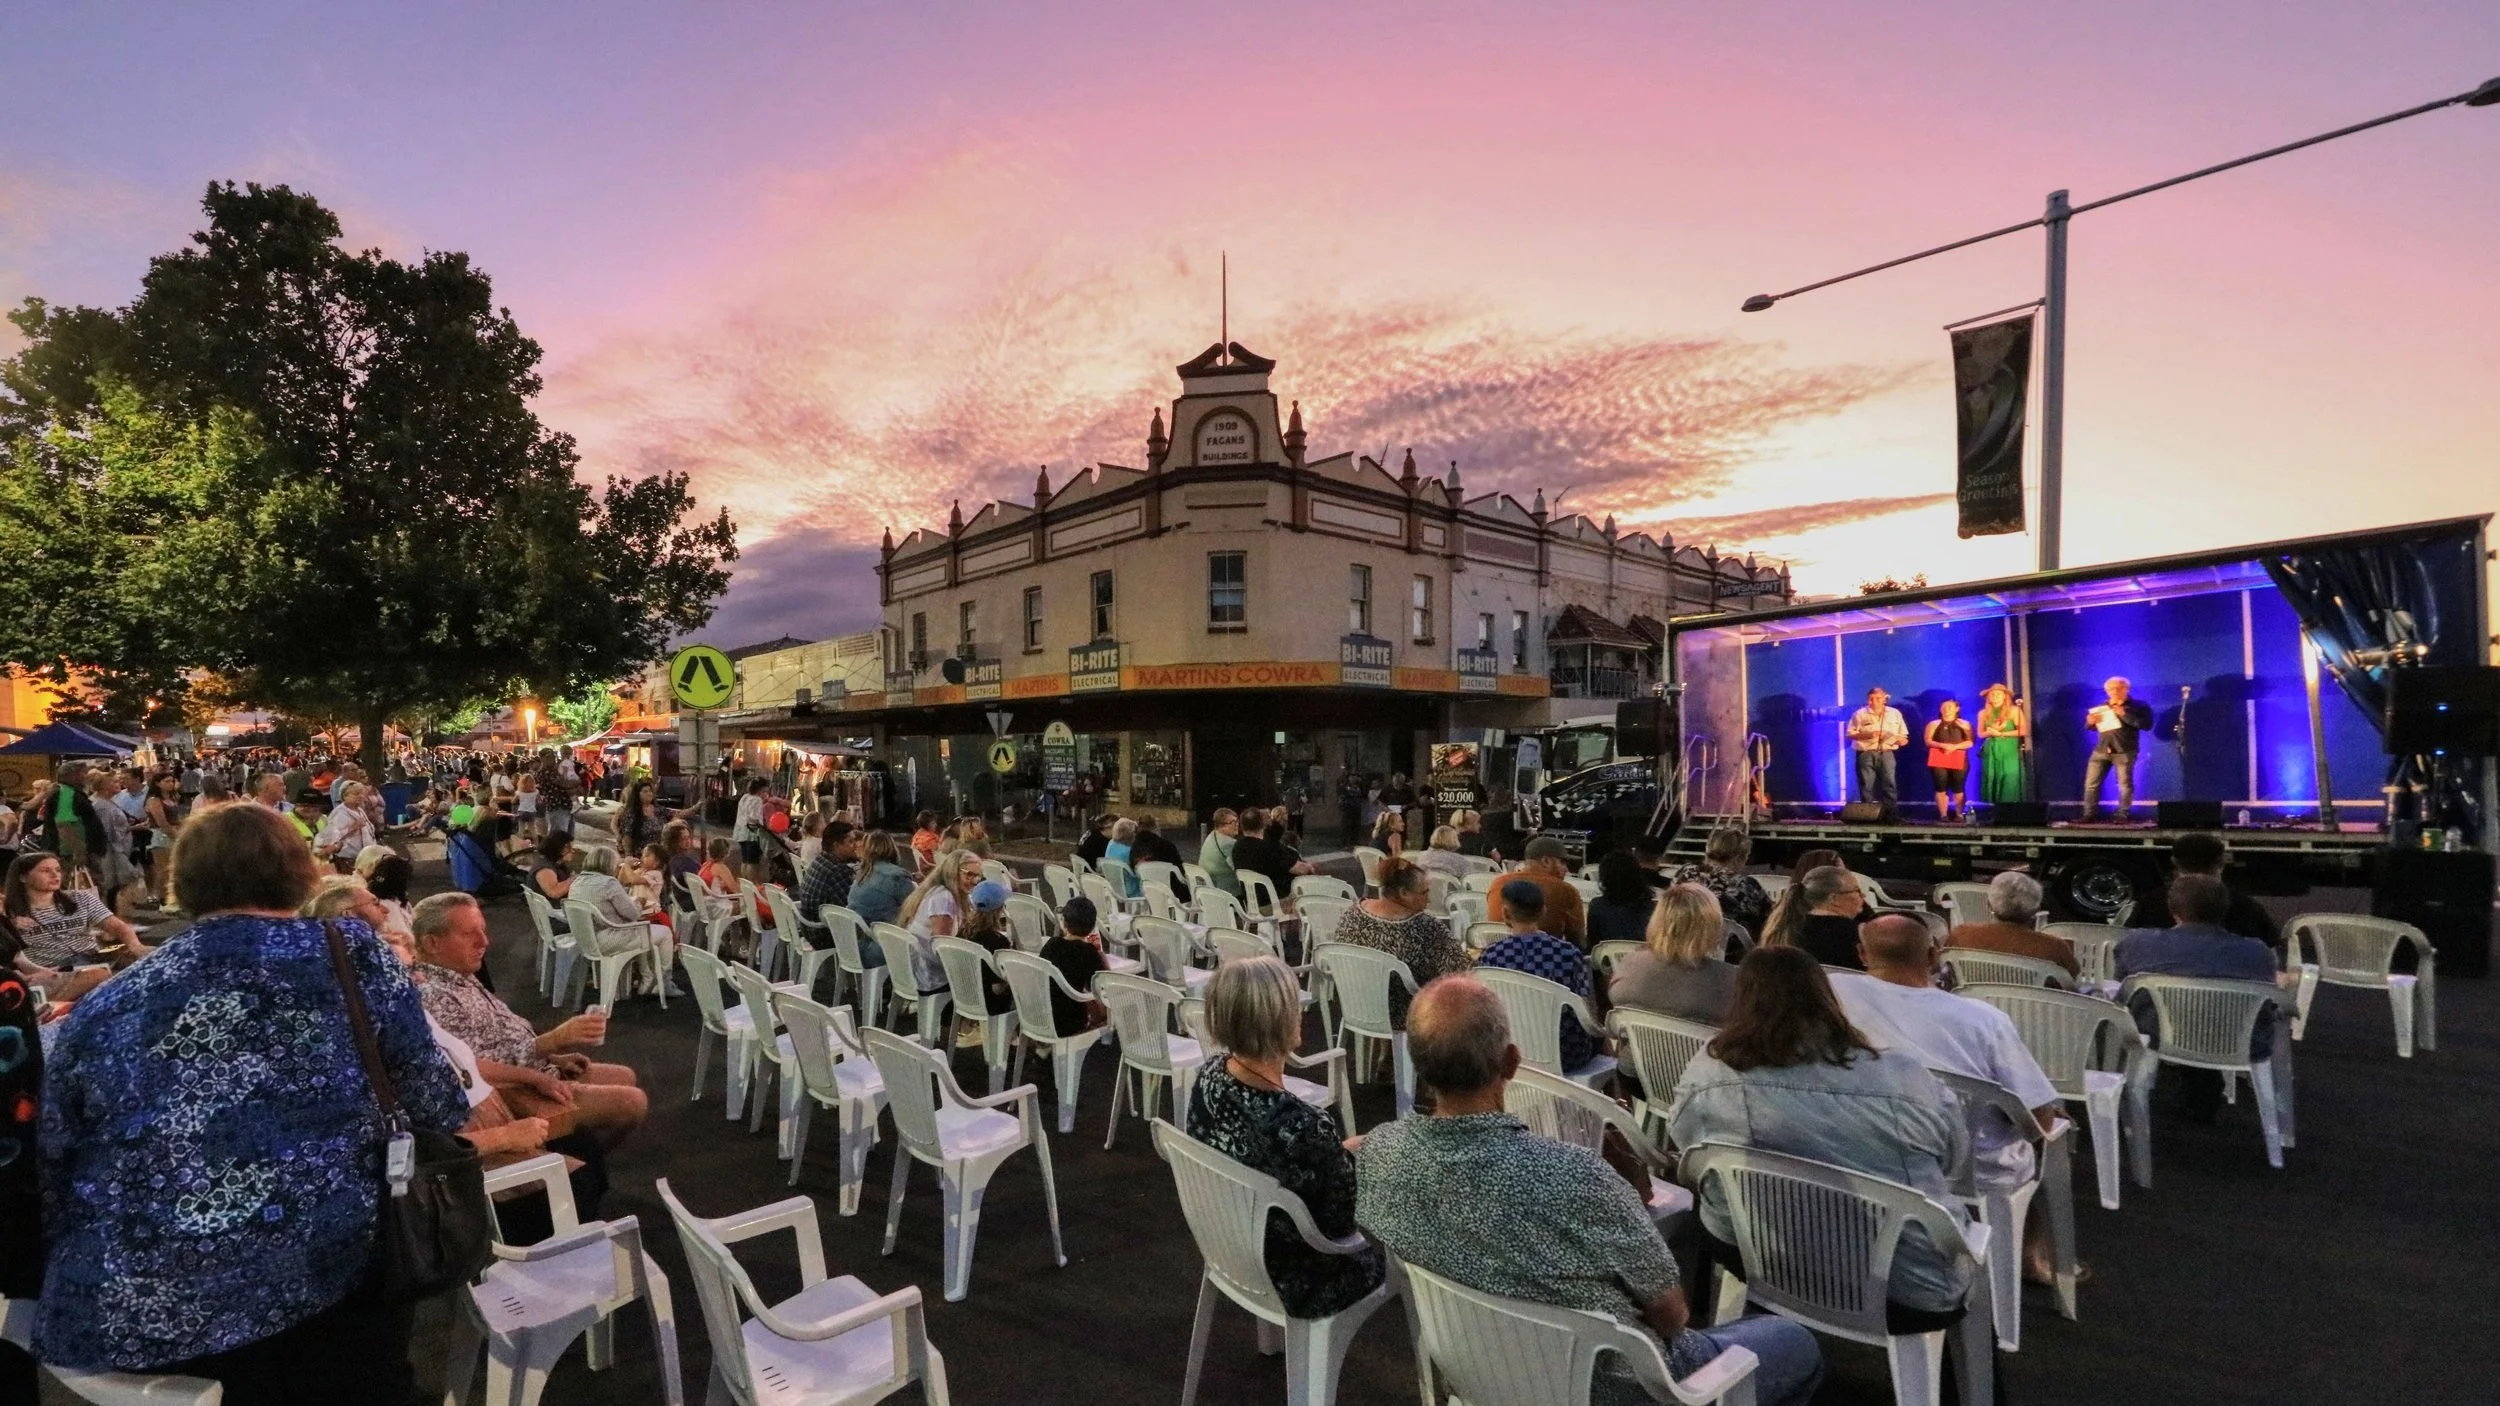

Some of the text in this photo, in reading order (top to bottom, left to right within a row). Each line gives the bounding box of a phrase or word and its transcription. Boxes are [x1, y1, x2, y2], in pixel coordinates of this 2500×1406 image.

[1206, 435, 1245, 446] FAGANS
[1202, 452, 1249, 461] BUILDINGS
[1720, 582, 1779, 596] NEWSAGENT
[1071, 649, 1118, 672] BI-RITE
[1342, 643, 1390, 666] BI-RITE
[1459, 654, 1497, 674] BI-RITE
[965, 664, 1000, 683] BI-RITE
[1073, 673, 1117, 688] ELECTRICAL
[1138, 666, 1324, 685] MARTINS COWRA
[1344, 670, 1389, 683] ELECTRICAL
[967, 686, 1000, 699] ELECTRICAL
[1011, 678, 1059, 695] MARTINS
[1048, 736, 1070, 745] COWRA
[1437, 792, 1474, 803] $20,000
